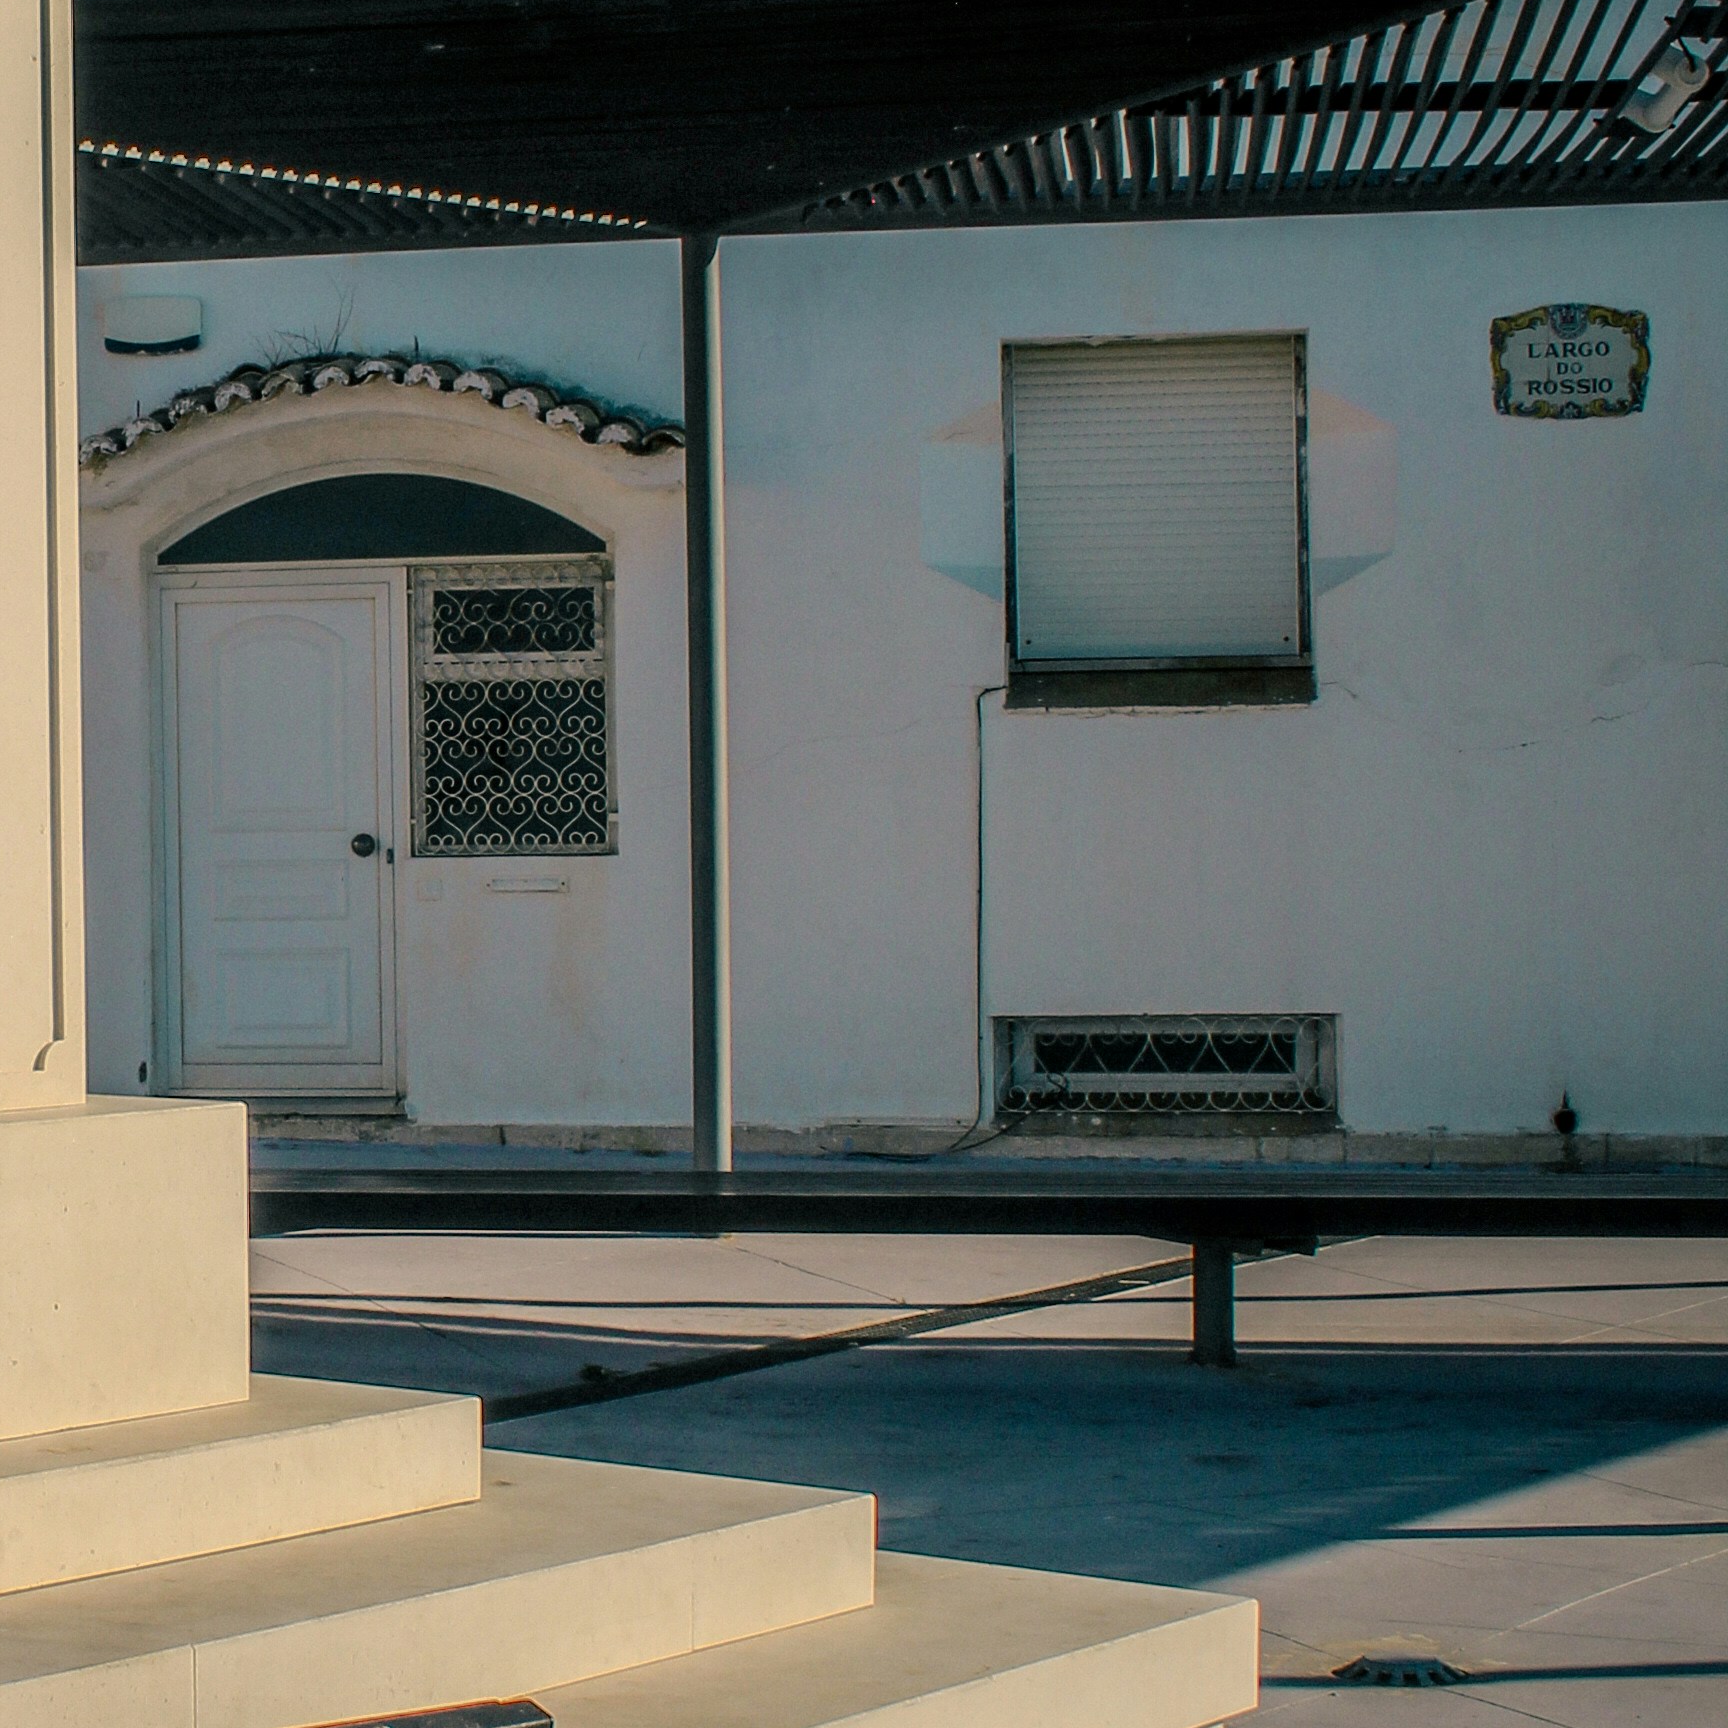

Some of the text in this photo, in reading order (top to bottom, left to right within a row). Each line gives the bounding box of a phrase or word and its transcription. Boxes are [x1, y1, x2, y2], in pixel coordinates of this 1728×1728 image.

[1528, 341, 1611, 359] LARGO
[1557, 362, 1583, 375] DO
[1528, 378, 1613, 395] ROSSIO
